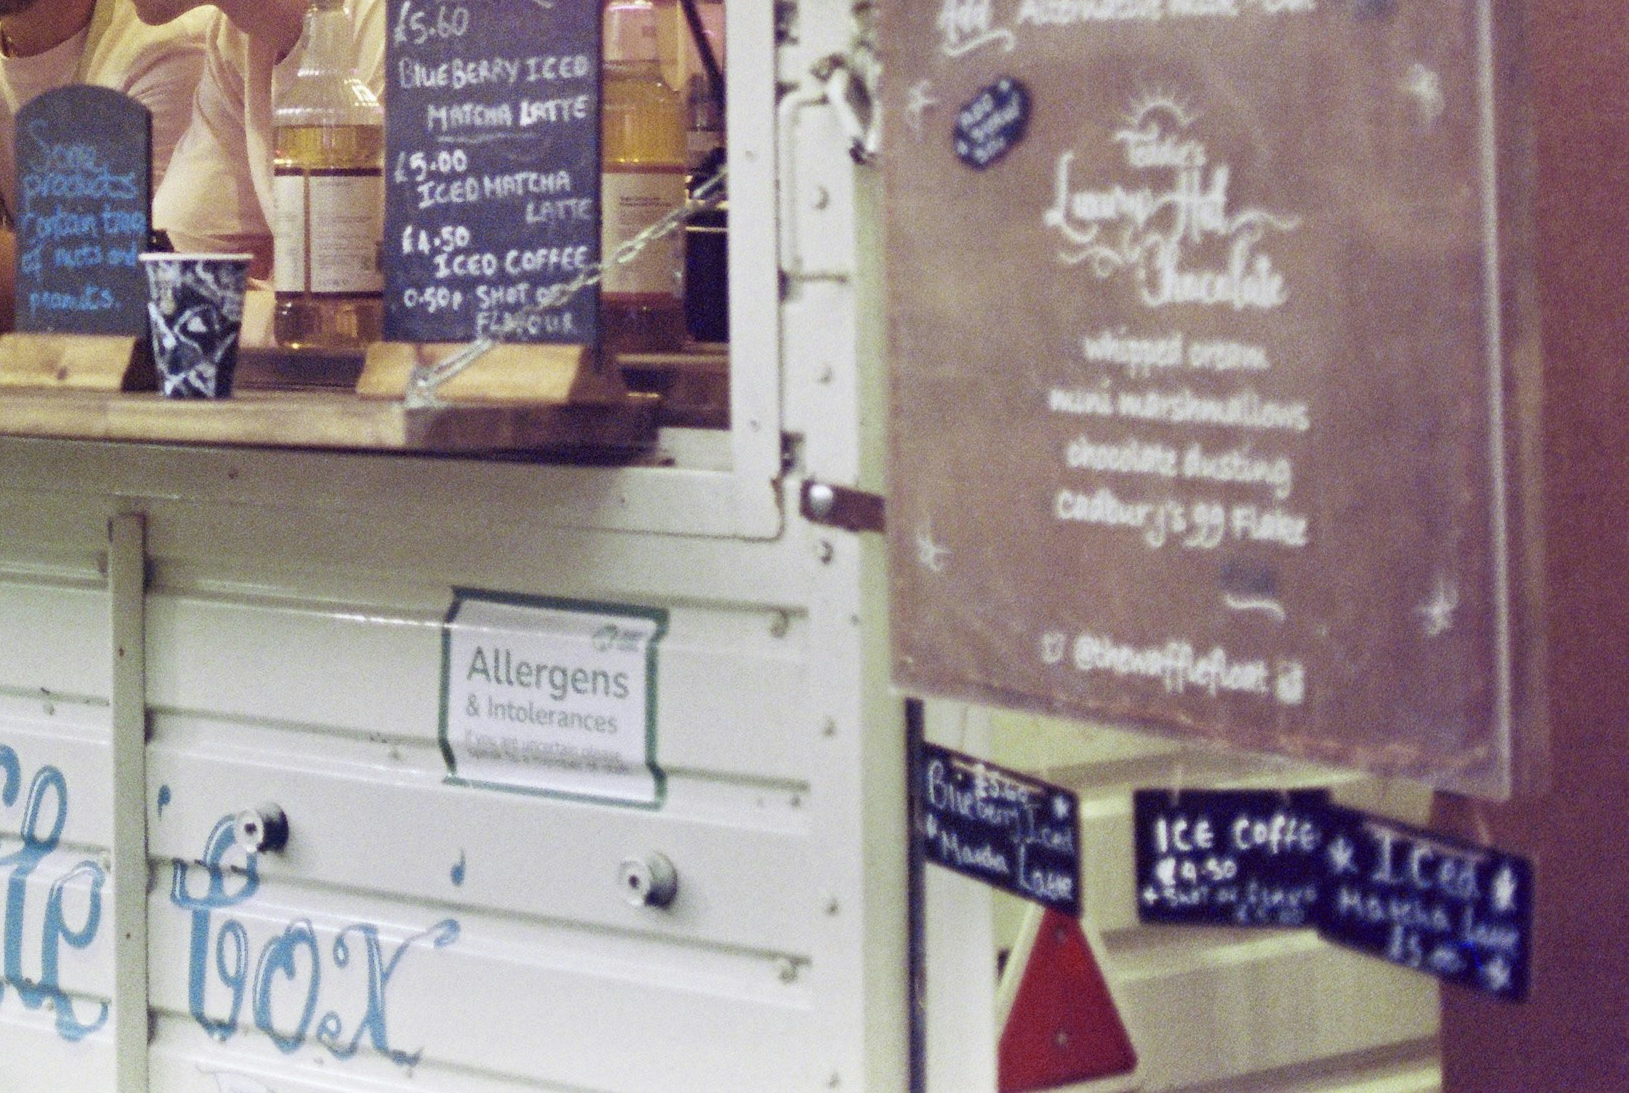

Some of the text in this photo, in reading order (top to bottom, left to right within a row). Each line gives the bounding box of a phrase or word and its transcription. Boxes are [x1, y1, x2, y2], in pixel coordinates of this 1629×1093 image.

[393, 0, 469, 46] £5.60
[526, 54, 591, 83] ICED
[427, 95, 590, 133] MATCHA LATTE
[393, 149, 468, 184] £5.00
[416, 170, 571, 209] ICED MATCHA
[526, 197, 593, 223] LATTE
[434, 245, 588, 279] ICED COFFEE
[476, 283, 531, 308] SHOT
[466, 645, 630, 701] Allergens
[465, 692, 619, 735] & Intolerances
[1156, 817, 1214, 853] ICE
